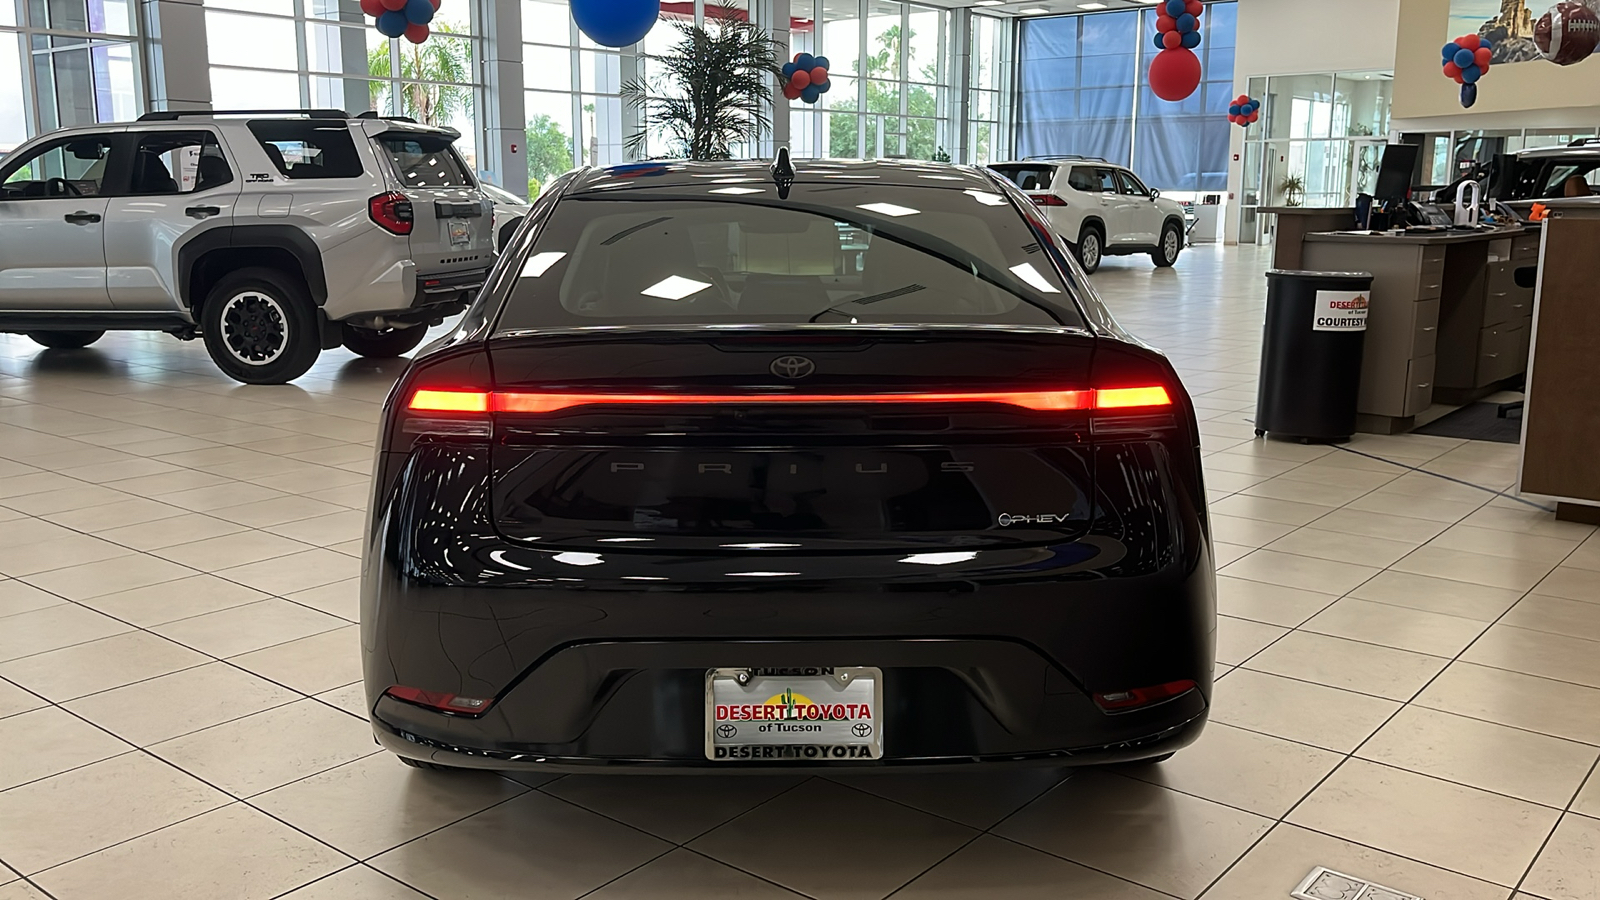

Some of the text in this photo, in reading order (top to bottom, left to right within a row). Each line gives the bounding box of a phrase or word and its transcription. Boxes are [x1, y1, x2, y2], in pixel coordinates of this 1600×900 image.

[1329, 301, 1359, 309] DESERT
[1317, 317, 1363, 327] COURTESY
[610, 462, 974, 474] PRIUS
[1011, 513, 1070, 524] PHEV
[752, 666, 835, 676] TUCSON
[716, 704, 872, 720] DESERT TOYOTA
[758, 723, 822, 732] of Tucson
[714, 745, 873, 758] DESERT TOYOTA
